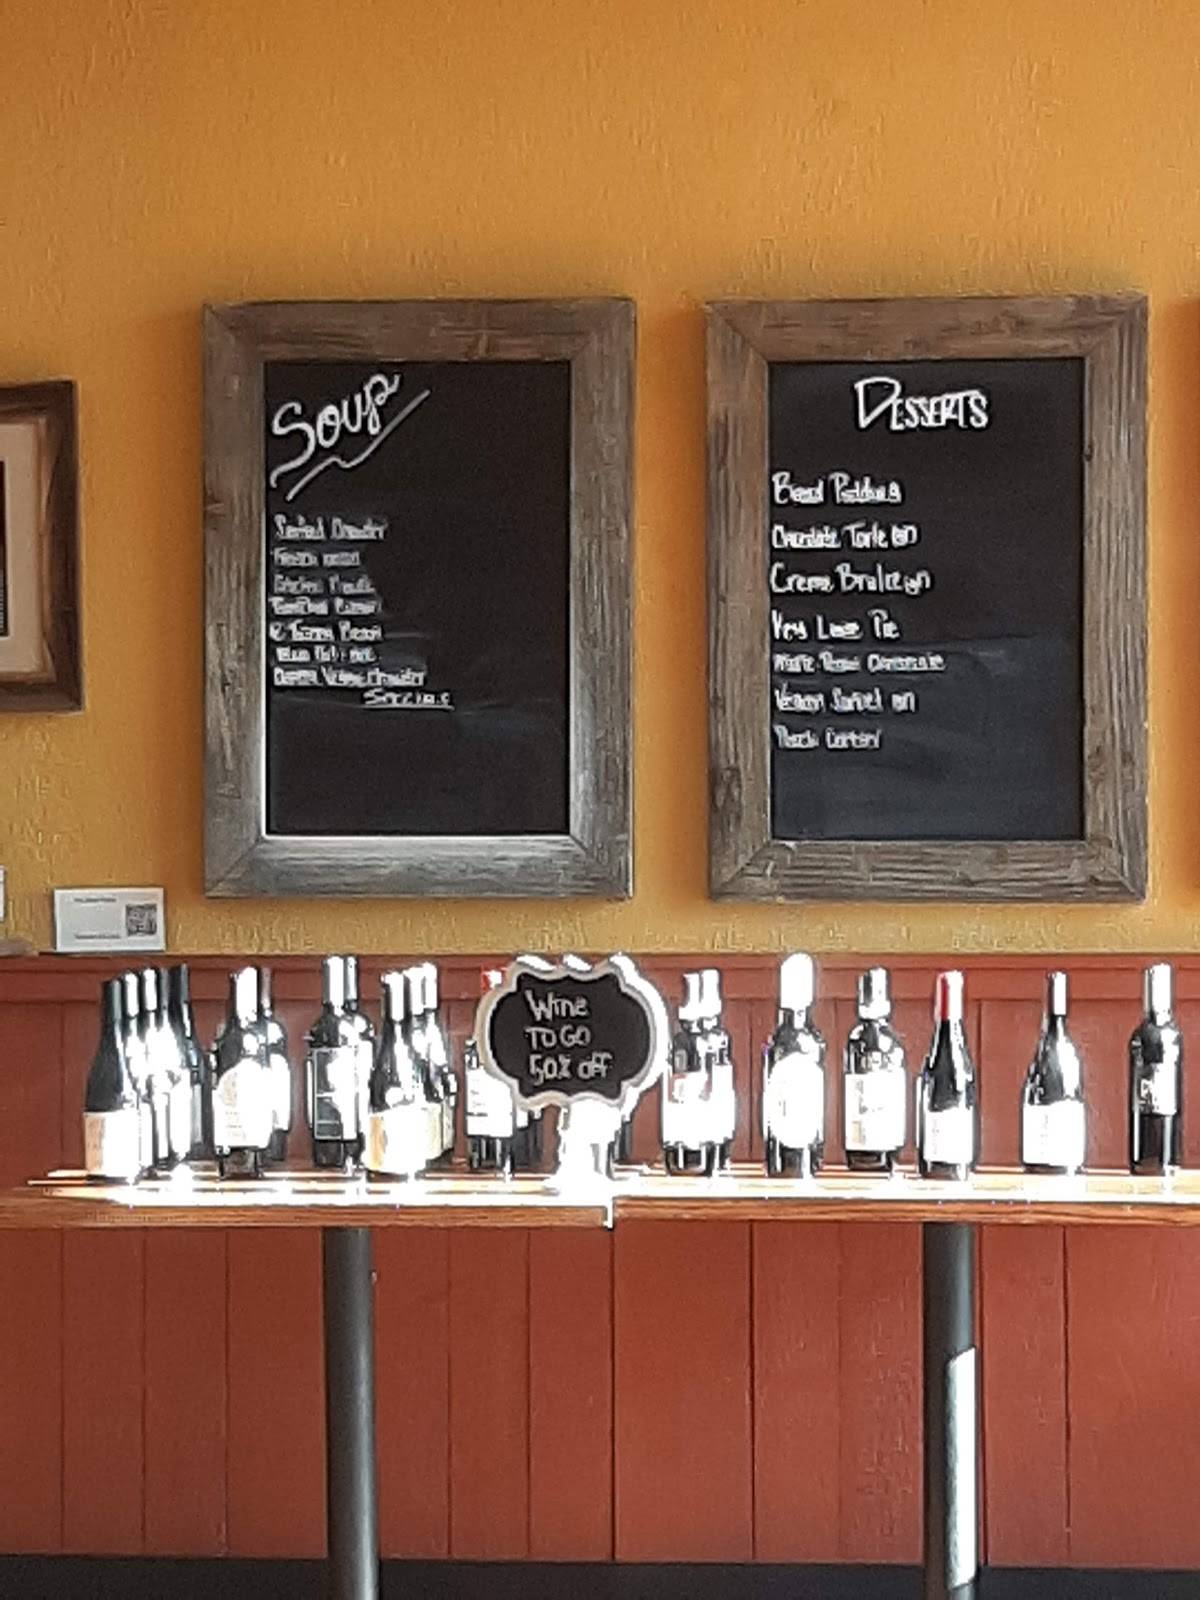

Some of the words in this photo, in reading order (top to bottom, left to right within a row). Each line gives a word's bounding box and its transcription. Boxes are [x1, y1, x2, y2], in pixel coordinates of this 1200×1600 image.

[270, 373, 400, 488] Soup
[525, 989, 588, 1022] Wine
[529, 1054, 571, 1087] 50%
